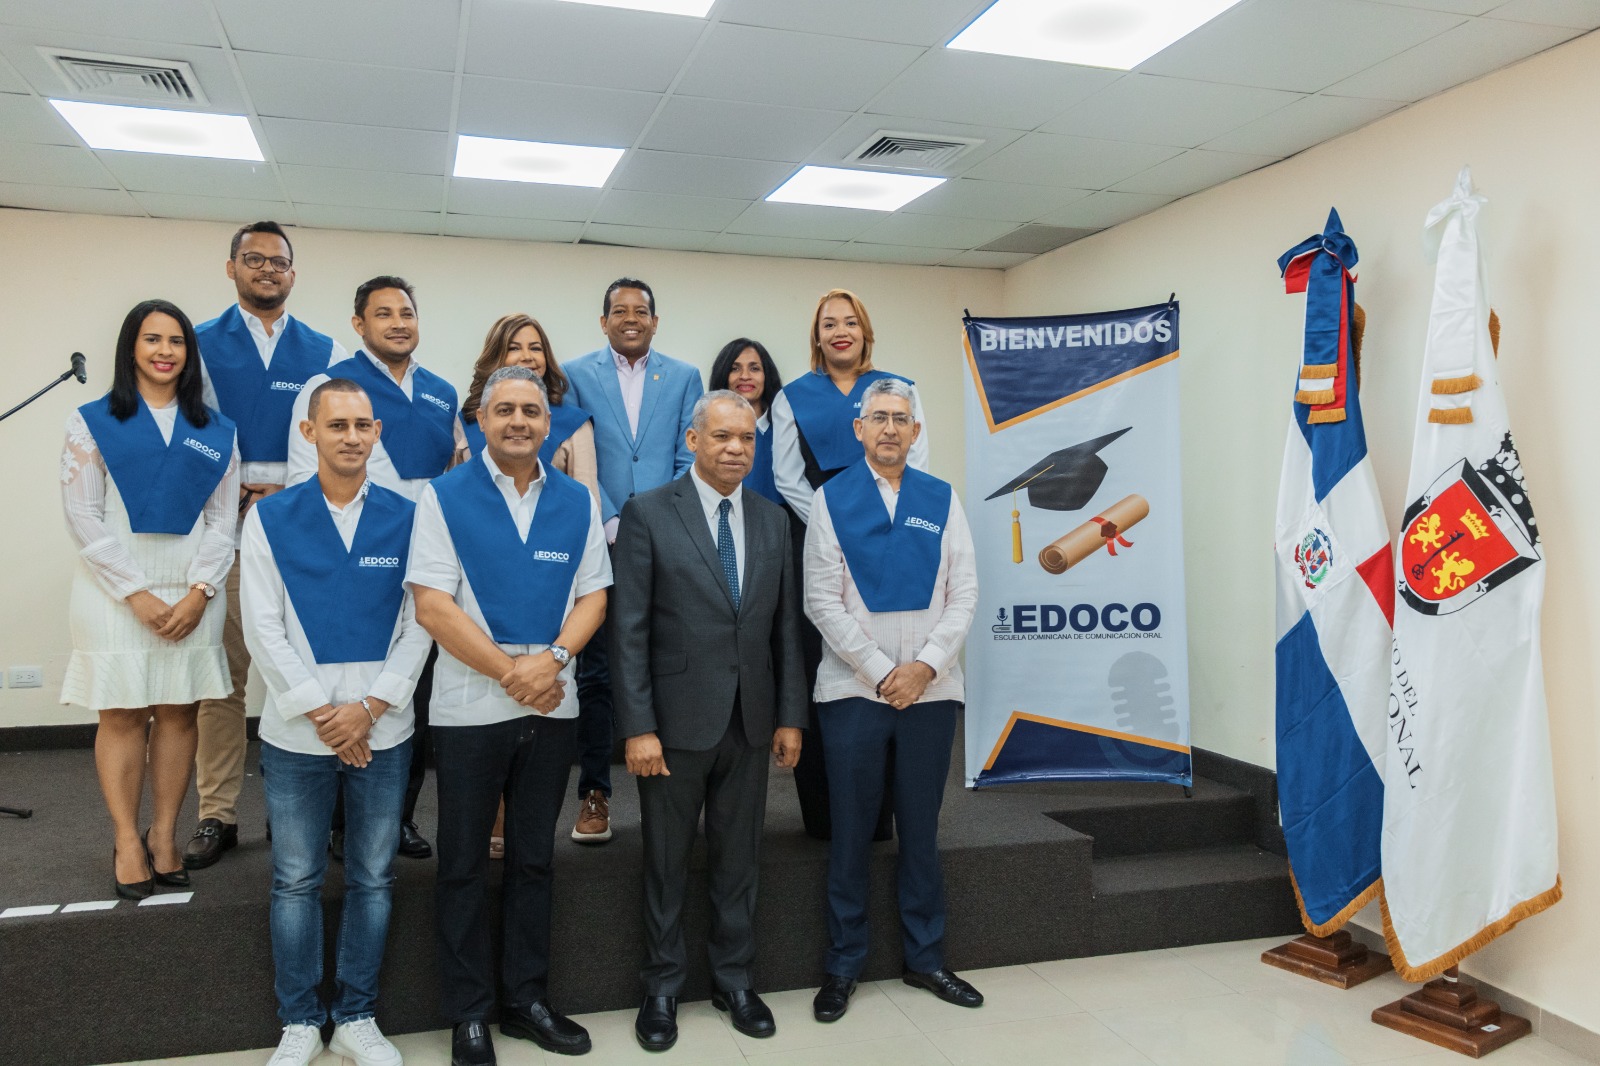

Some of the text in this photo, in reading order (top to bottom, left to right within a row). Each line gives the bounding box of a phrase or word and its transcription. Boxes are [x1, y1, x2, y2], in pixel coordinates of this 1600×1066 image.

[980, 319, 1172, 351] BIENVENIDOS
[190, 439, 221, 459] EDOCO
[911, 517, 941, 532] EDOCO
[364, 556, 399, 565] EDOCO
[538, 550, 570, 561] EDOCO
[1013, 602, 1162, 633] EDOCO
[1027, 633, 1073, 641] DOMINICANA
[1085, 632, 1142, 640] COMUNICACION
[1396, 669, 1419, 717] DEL
